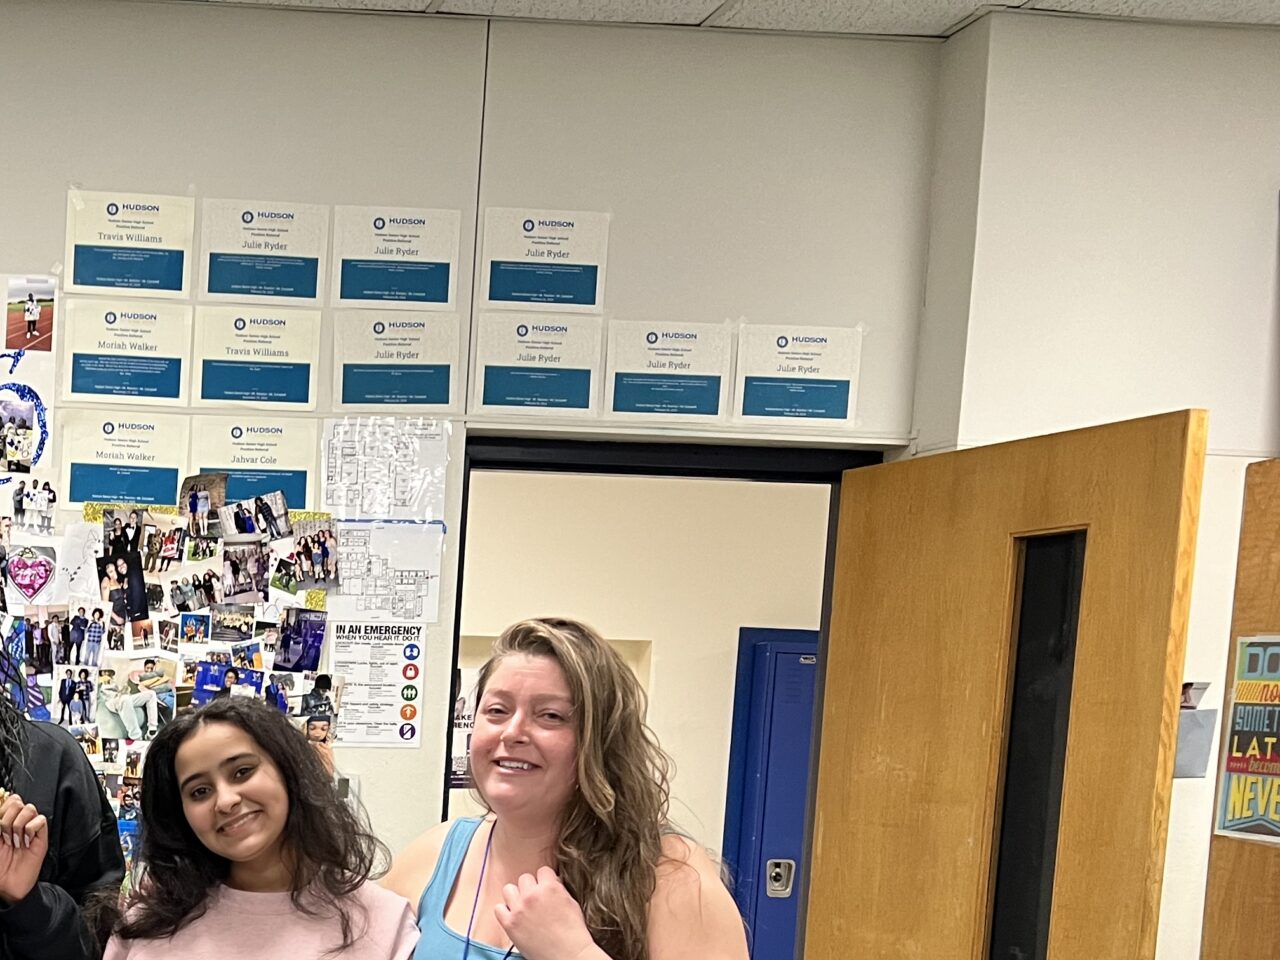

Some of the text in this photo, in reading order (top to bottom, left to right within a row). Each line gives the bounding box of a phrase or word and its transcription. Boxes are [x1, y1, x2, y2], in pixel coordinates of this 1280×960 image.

[539, 220, 574, 228] HUDSON
[98, 232, 162, 243] Travis Williams
[264, 242, 287, 251] Ryder
[396, 248, 419, 256] Ryder
[525, 249, 569, 259] Julie Ryder
[121, 312, 156, 320] HUDSON
[98, 341, 158, 351] Moriah Walker
[226, 347, 288, 356] Travis Williams
[397, 351, 419, 360] Ryder
[517, 353, 560, 363] Julie Ryder
[798, 365, 820, 374] Ryder
[96, 451, 155, 461] Moriah Walker
[336, 625, 422, 635] IN AN EMERGENCY
